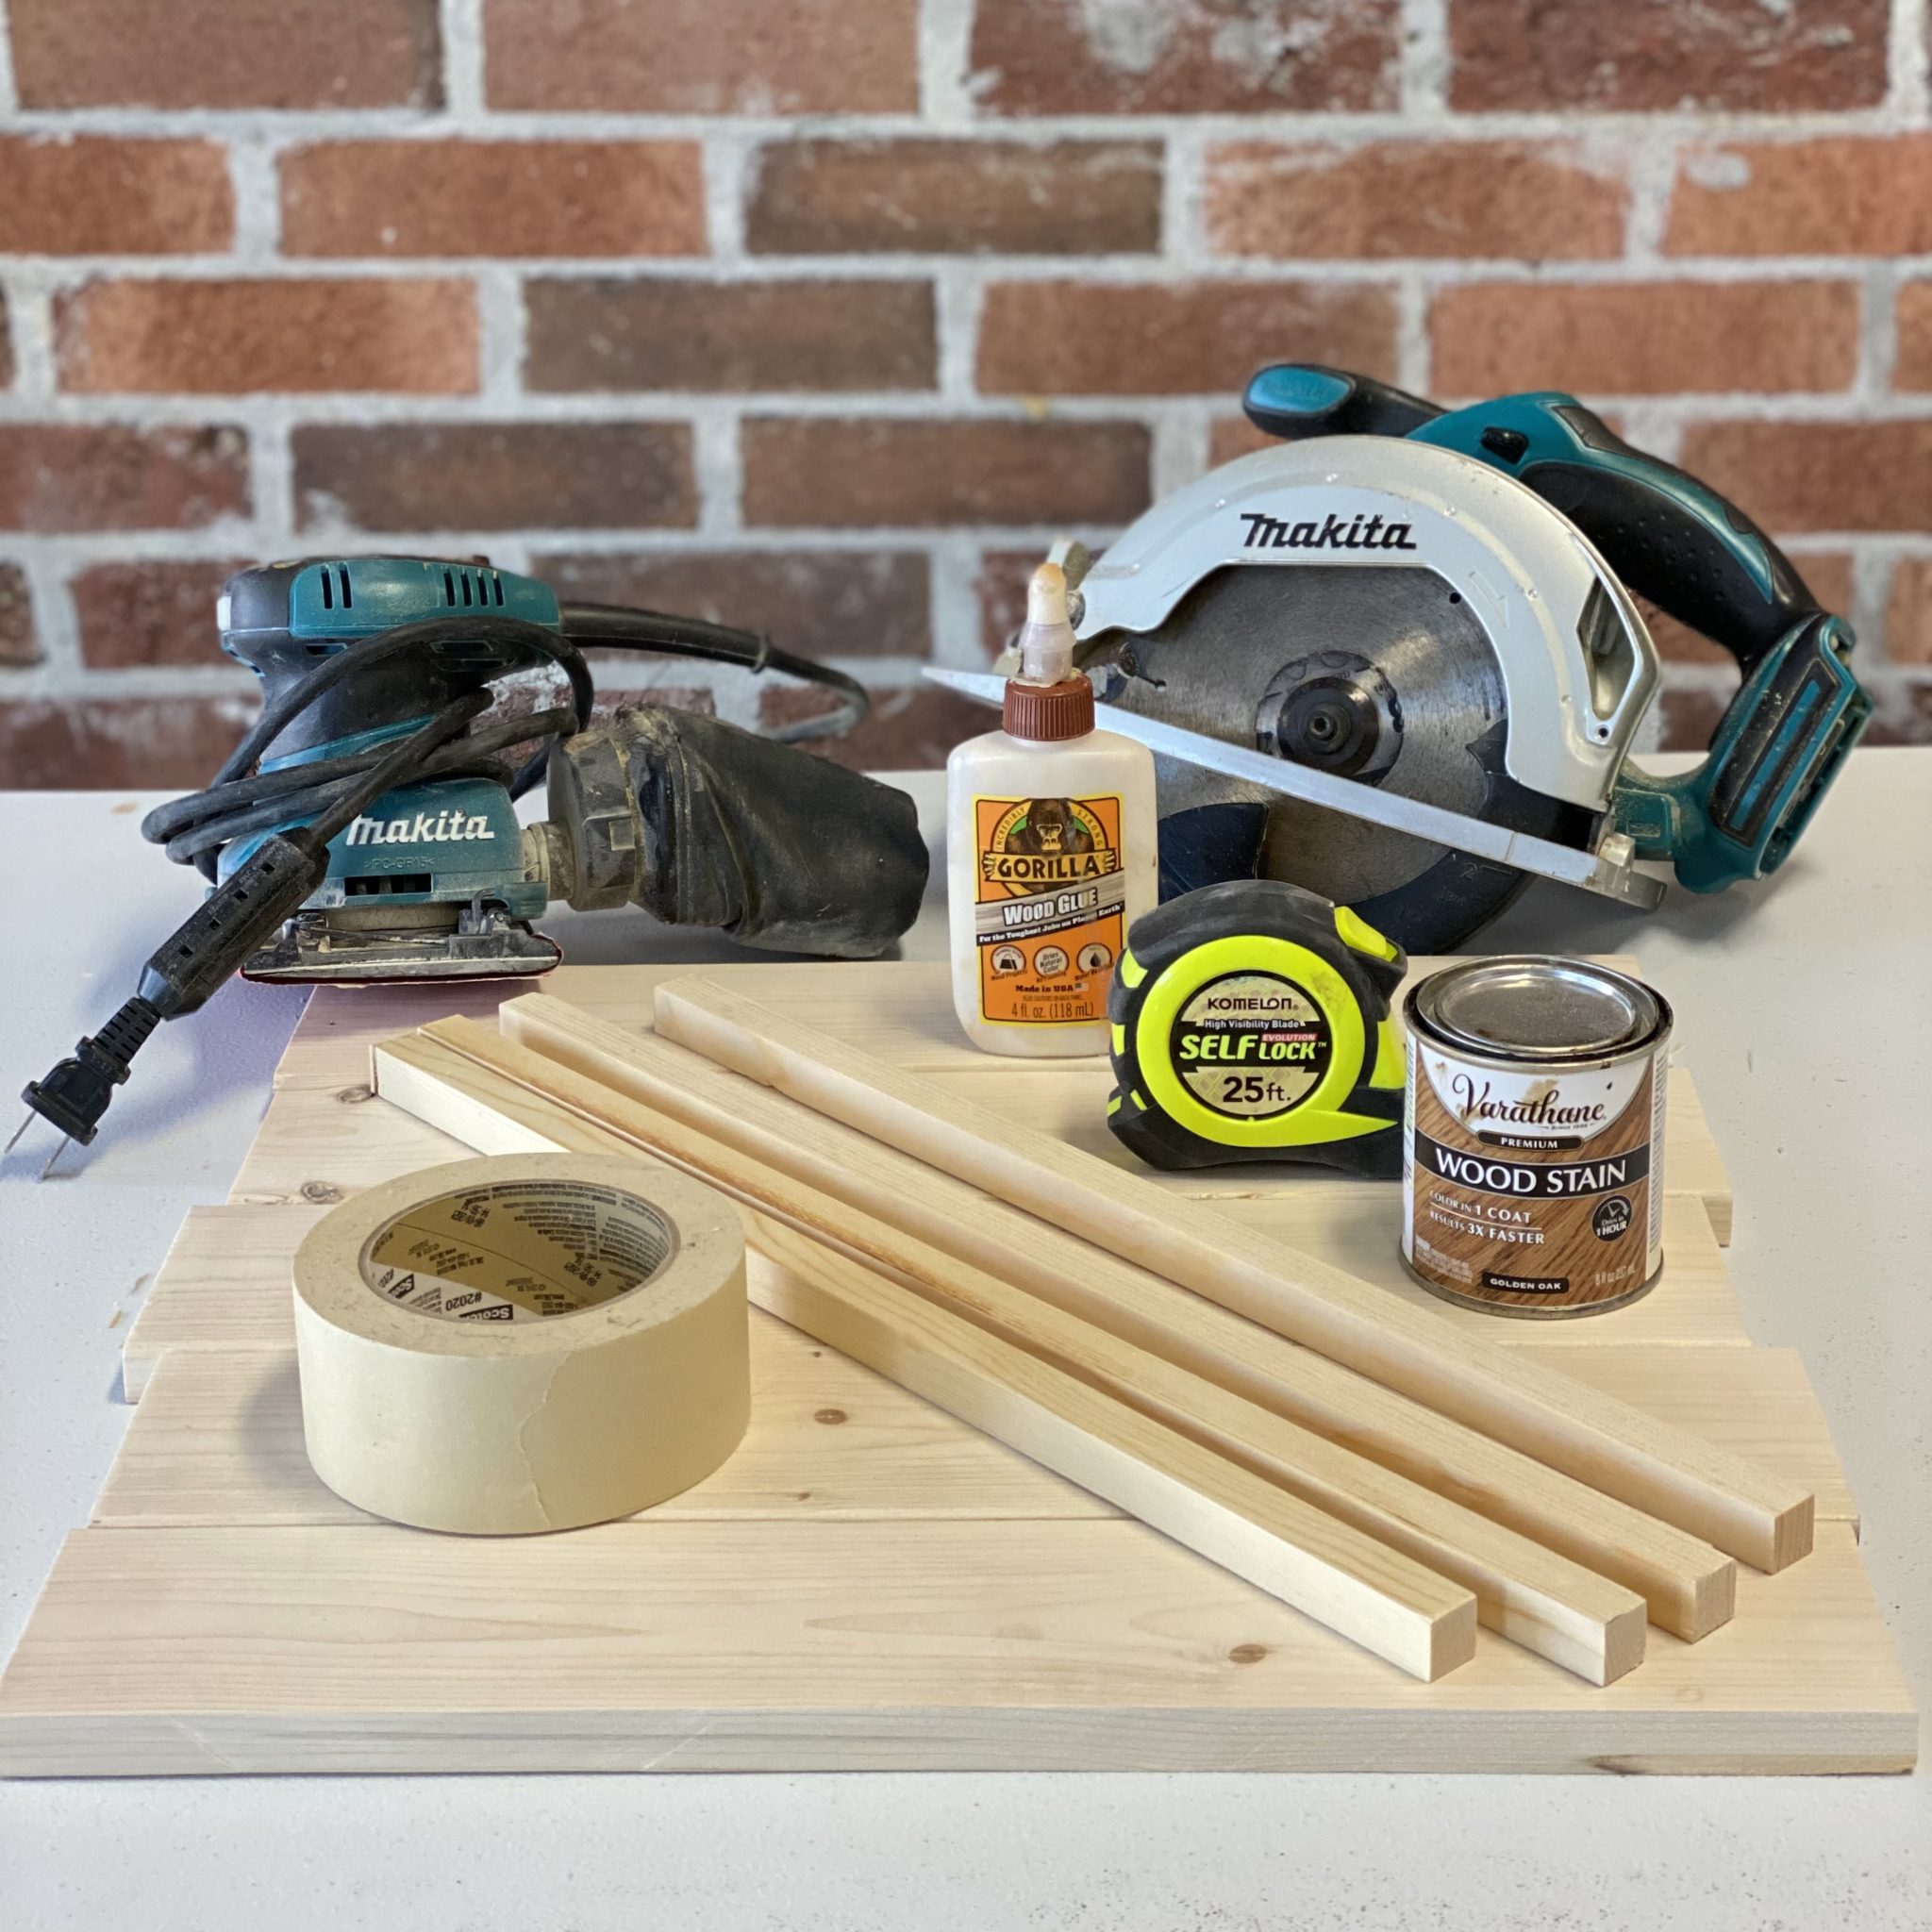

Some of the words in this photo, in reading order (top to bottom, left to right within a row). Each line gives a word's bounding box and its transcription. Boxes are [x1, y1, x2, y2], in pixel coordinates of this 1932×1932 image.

[1241, 513, 1417, 549] Makita
[996, 808, 1024, 849] INCREDIBLY
[1077, 809, 1104, 845] STRONG
[998, 856, 1101, 879] GORILLA
[979, 935, 991, 943] For
[1007, 926, 1041, 939] Toughest
[1042, 923, 1061, 932] Jobs
[1099, 904, 1122, 917] Earth
[1041, 957, 1063, 968] Natural
[1042, 952, 1059, 960] Dries
[1043, 965, 1059, 974] Color
[1053, 984, 1074, 992] USA
[1011, 1003, 1018, 1017] 4
[1033, 1007, 1046, 1019] oz.
[1050, 1003, 1072, 1020] (118
[1075, 1002, 1094, 1018] mL)
[1205, 1020, 1227, 1030] High
[1228, 1020, 1270, 1030] Visibility
[1273, 1020, 1299, 1028] Blade
[1179, 1035, 1259, 1060] SELF
[1452, 1073, 1606, 1125] Varathane
[1501, 1137, 1558, 1149] PREMIUM
[1435, 1148, 1537, 1193] WOOD
[1547, 1159, 1626, 1193] STAIN
[1430, 1191, 1458, 1208] COLOR
[1461, 1203, 1472, 1213] IN
[1475, 1205, 1482, 1216] 1
[1487, 1208, 1532, 1224] COAT
[1429, 1209, 1465, 1231] RESULTS
[1467, 1223, 1484, 1237] 3X
[1490, 1228, 1545, 1244] FASTER
[1596, 1227, 1602, 1237] 1
[1602, 1220, 1627, 1236] HOUR
[1490, 1277, 1535, 1290] GOLDEN
[1538, 1280, 1562, 1291] OAK
[445, 1291, 483, 1312] #2020
